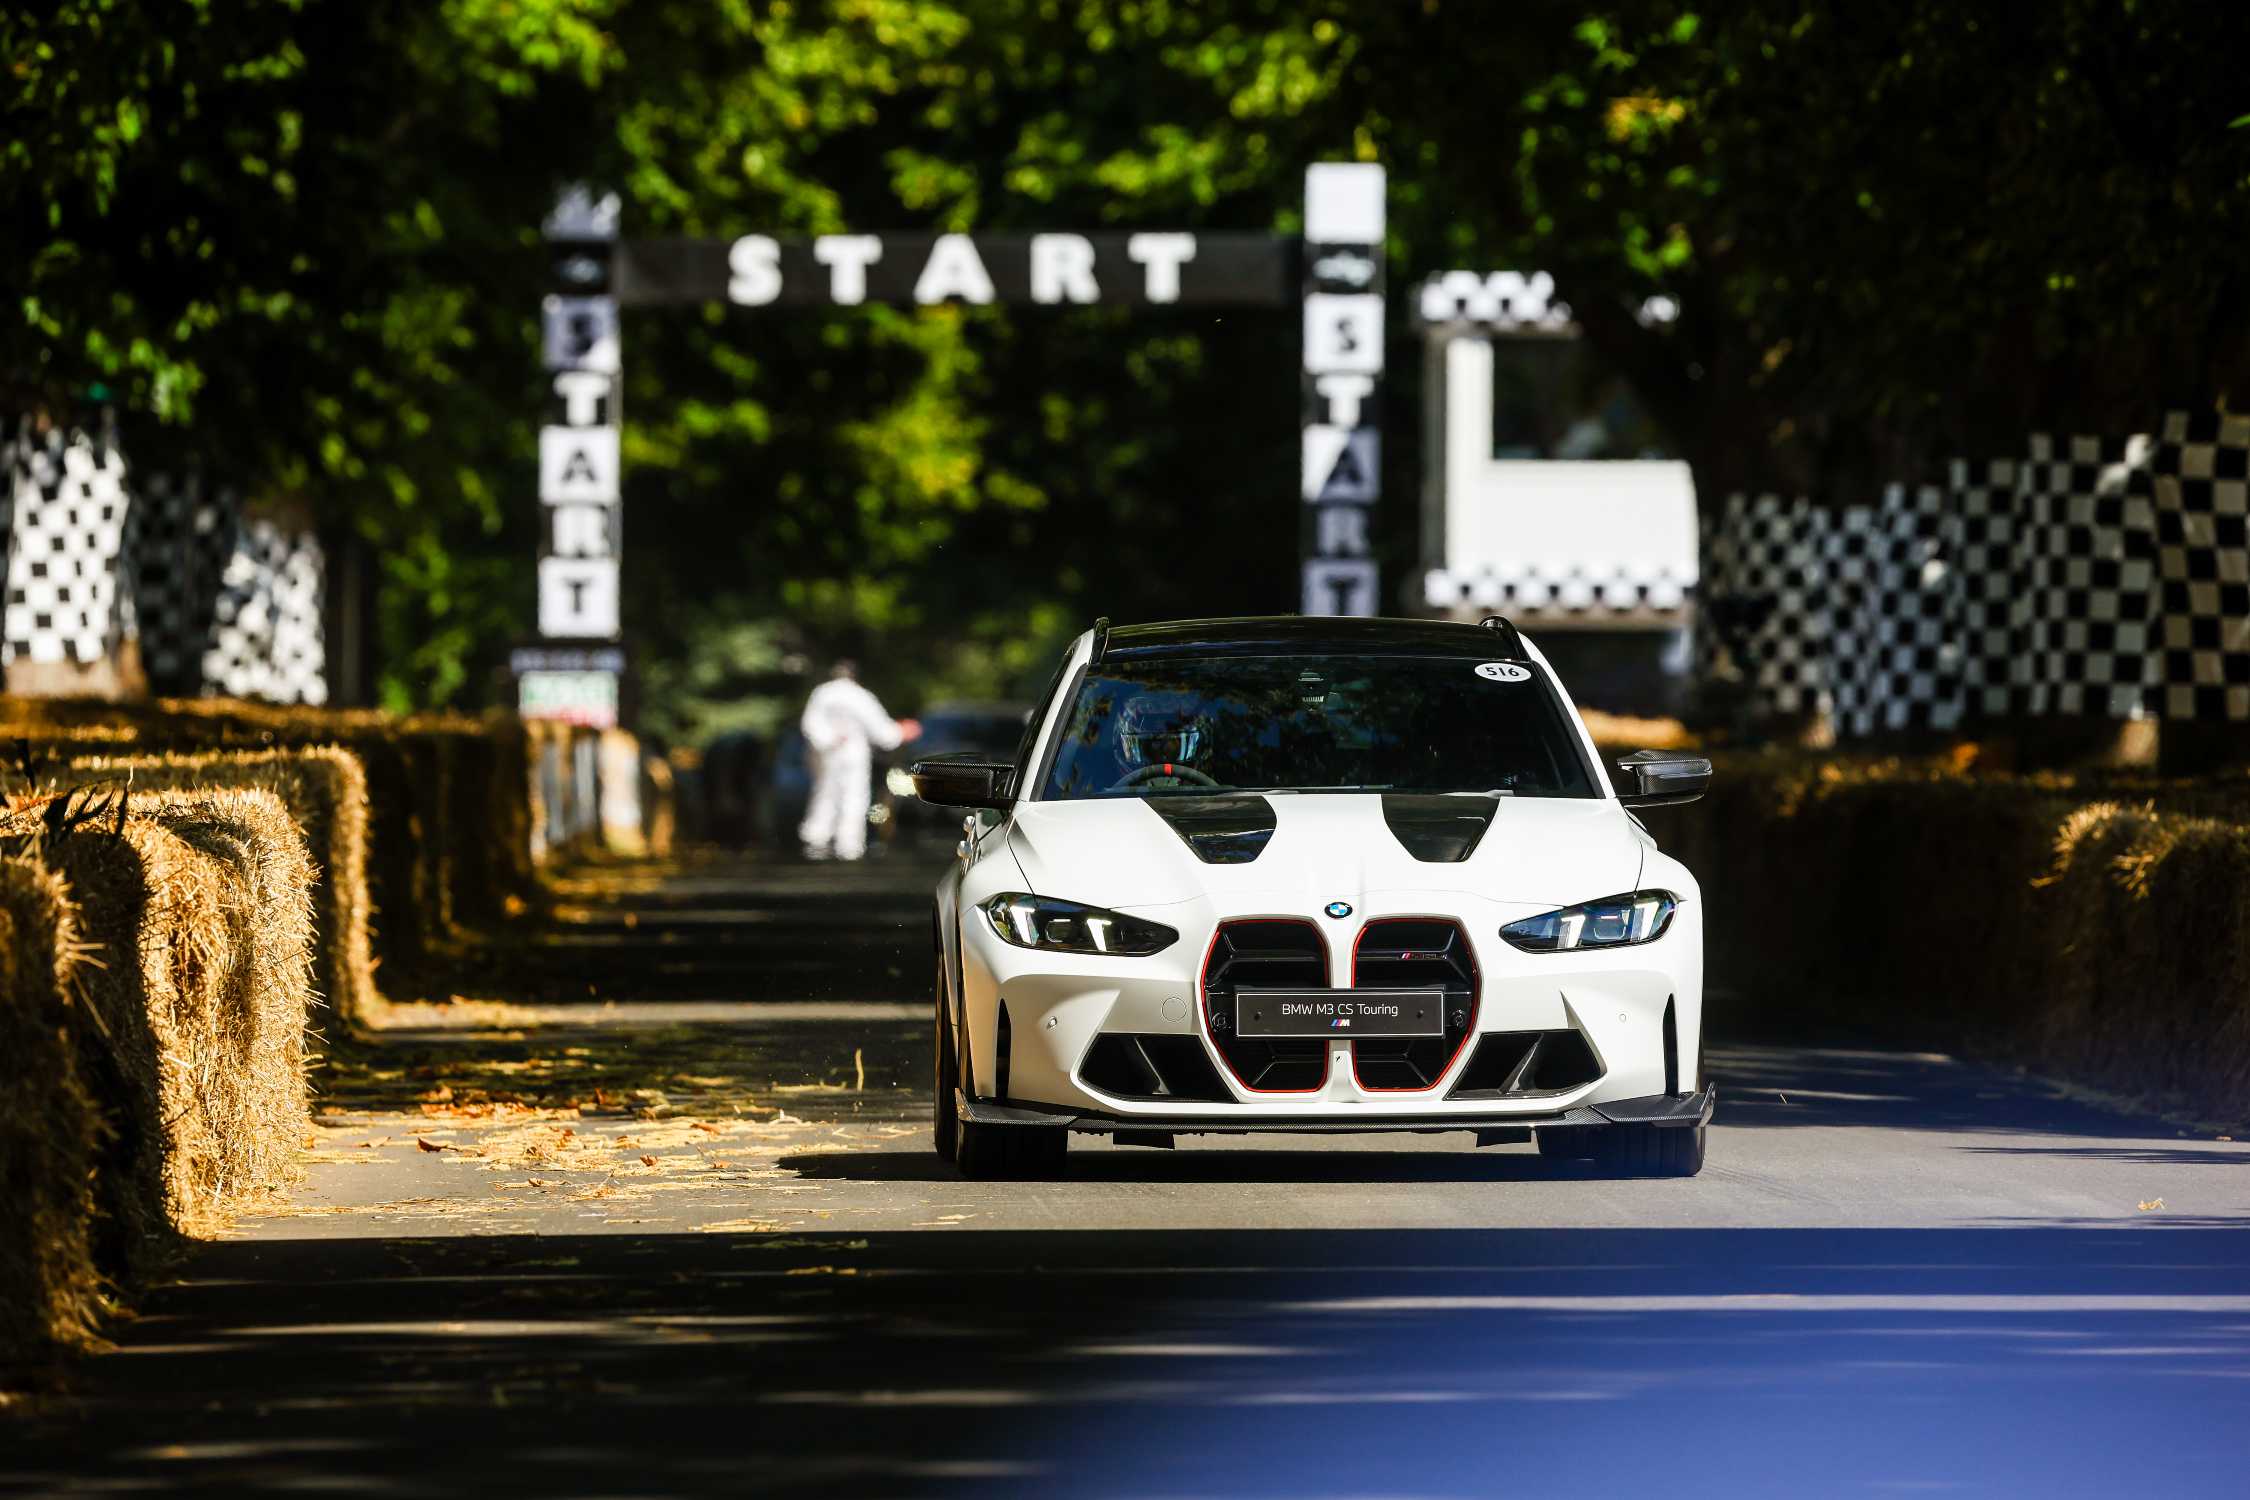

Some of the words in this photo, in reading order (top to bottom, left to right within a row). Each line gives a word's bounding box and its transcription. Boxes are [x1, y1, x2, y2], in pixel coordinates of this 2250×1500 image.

[727, 233, 1197, 306] START
[1486, 667, 1519, 677] 516
[1282, 1003, 1313, 1015] BMW
[1316, 1003, 1334, 1015] M3
[1337, 1003, 1354, 1015] CS
[1356, 1003, 1399, 1016] Touring
